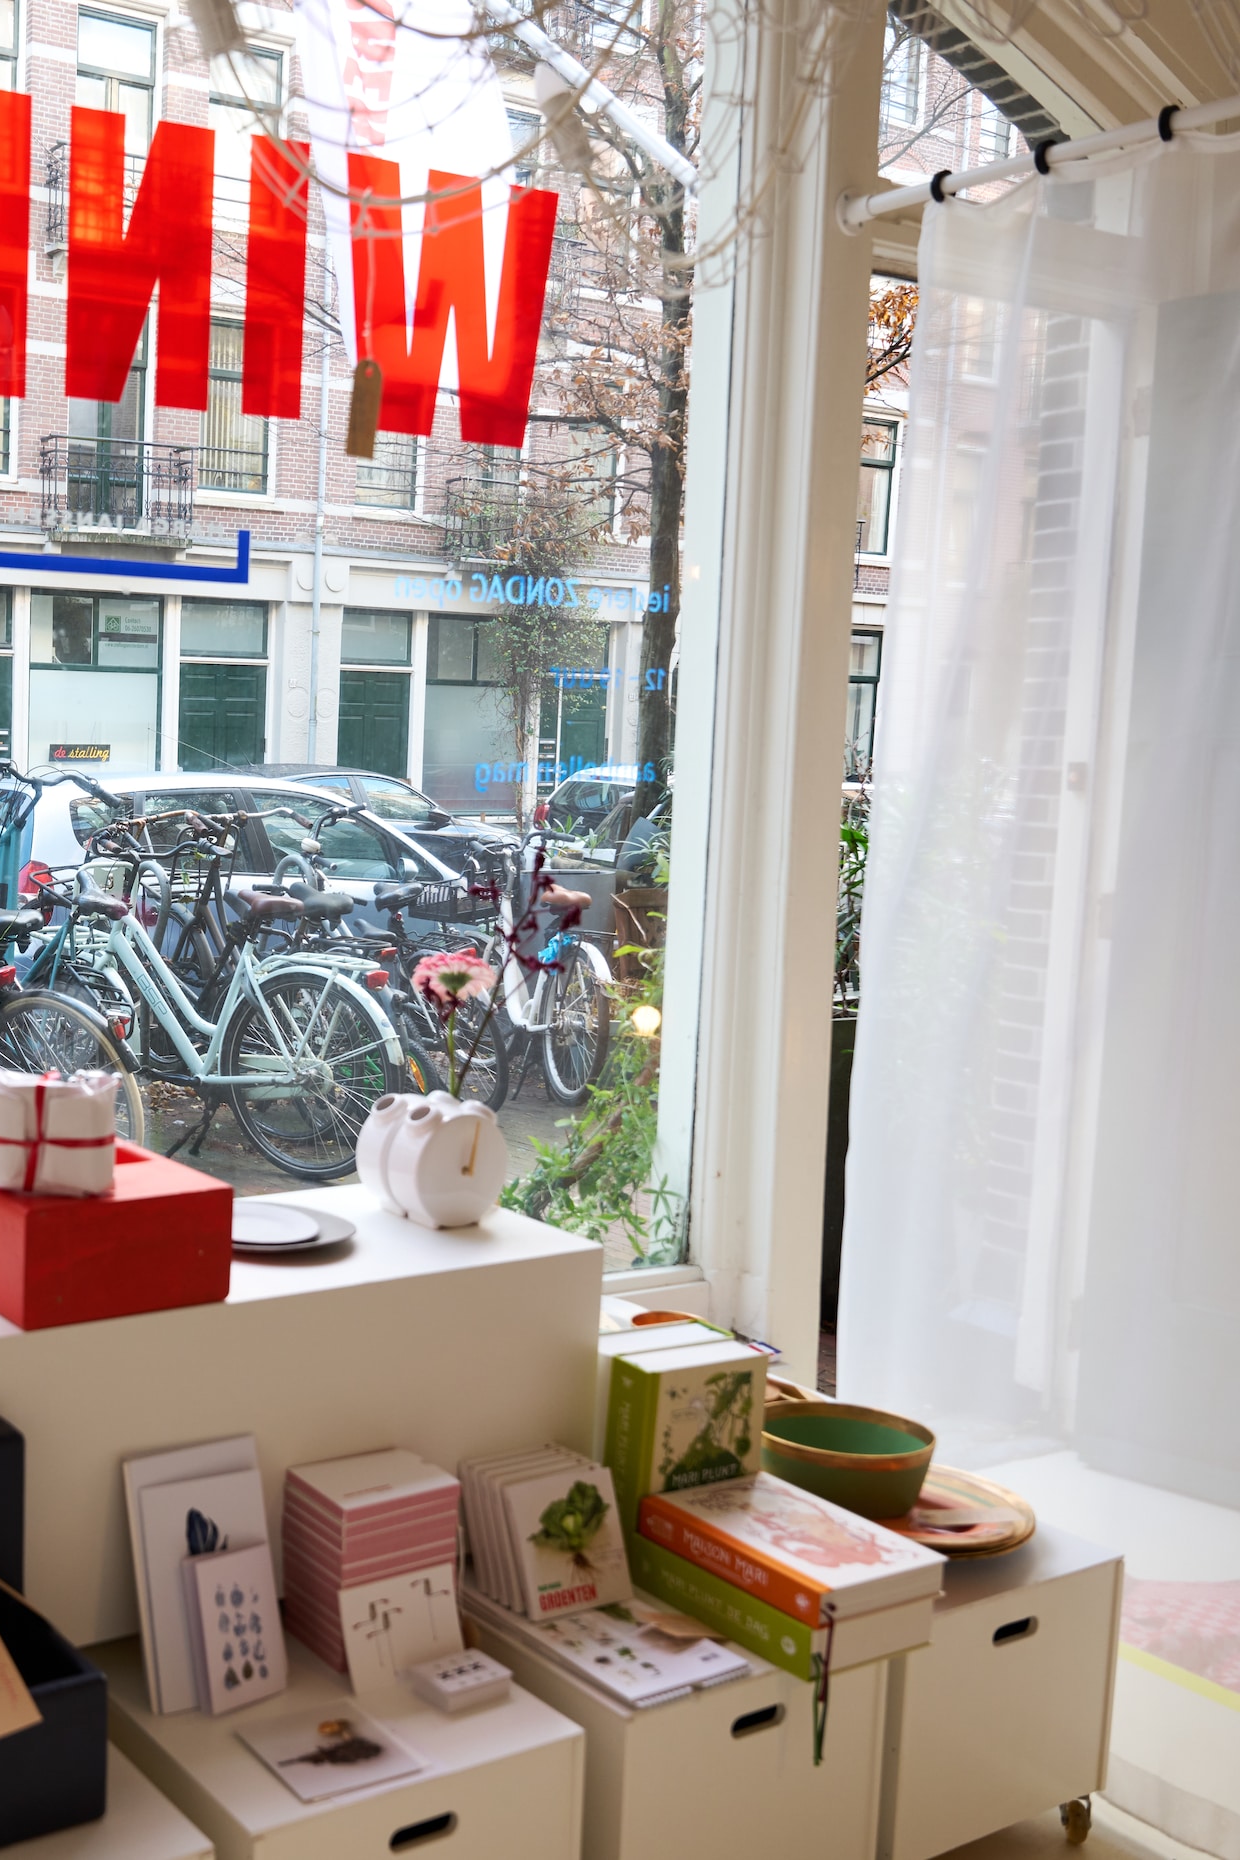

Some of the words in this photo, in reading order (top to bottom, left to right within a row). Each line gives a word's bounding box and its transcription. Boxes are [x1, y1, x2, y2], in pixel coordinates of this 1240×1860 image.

[54, 746, 67, 758] de
[69, 745, 110, 763] stalling
[136, 973, 168, 1015] BSP
[682, 1527, 732, 1567] MAISON
[734, 1557, 770, 1586] MARI
[538, 1583, 598, 1612] GROENTEN
[745, 1614, 770, 1641] DAG
